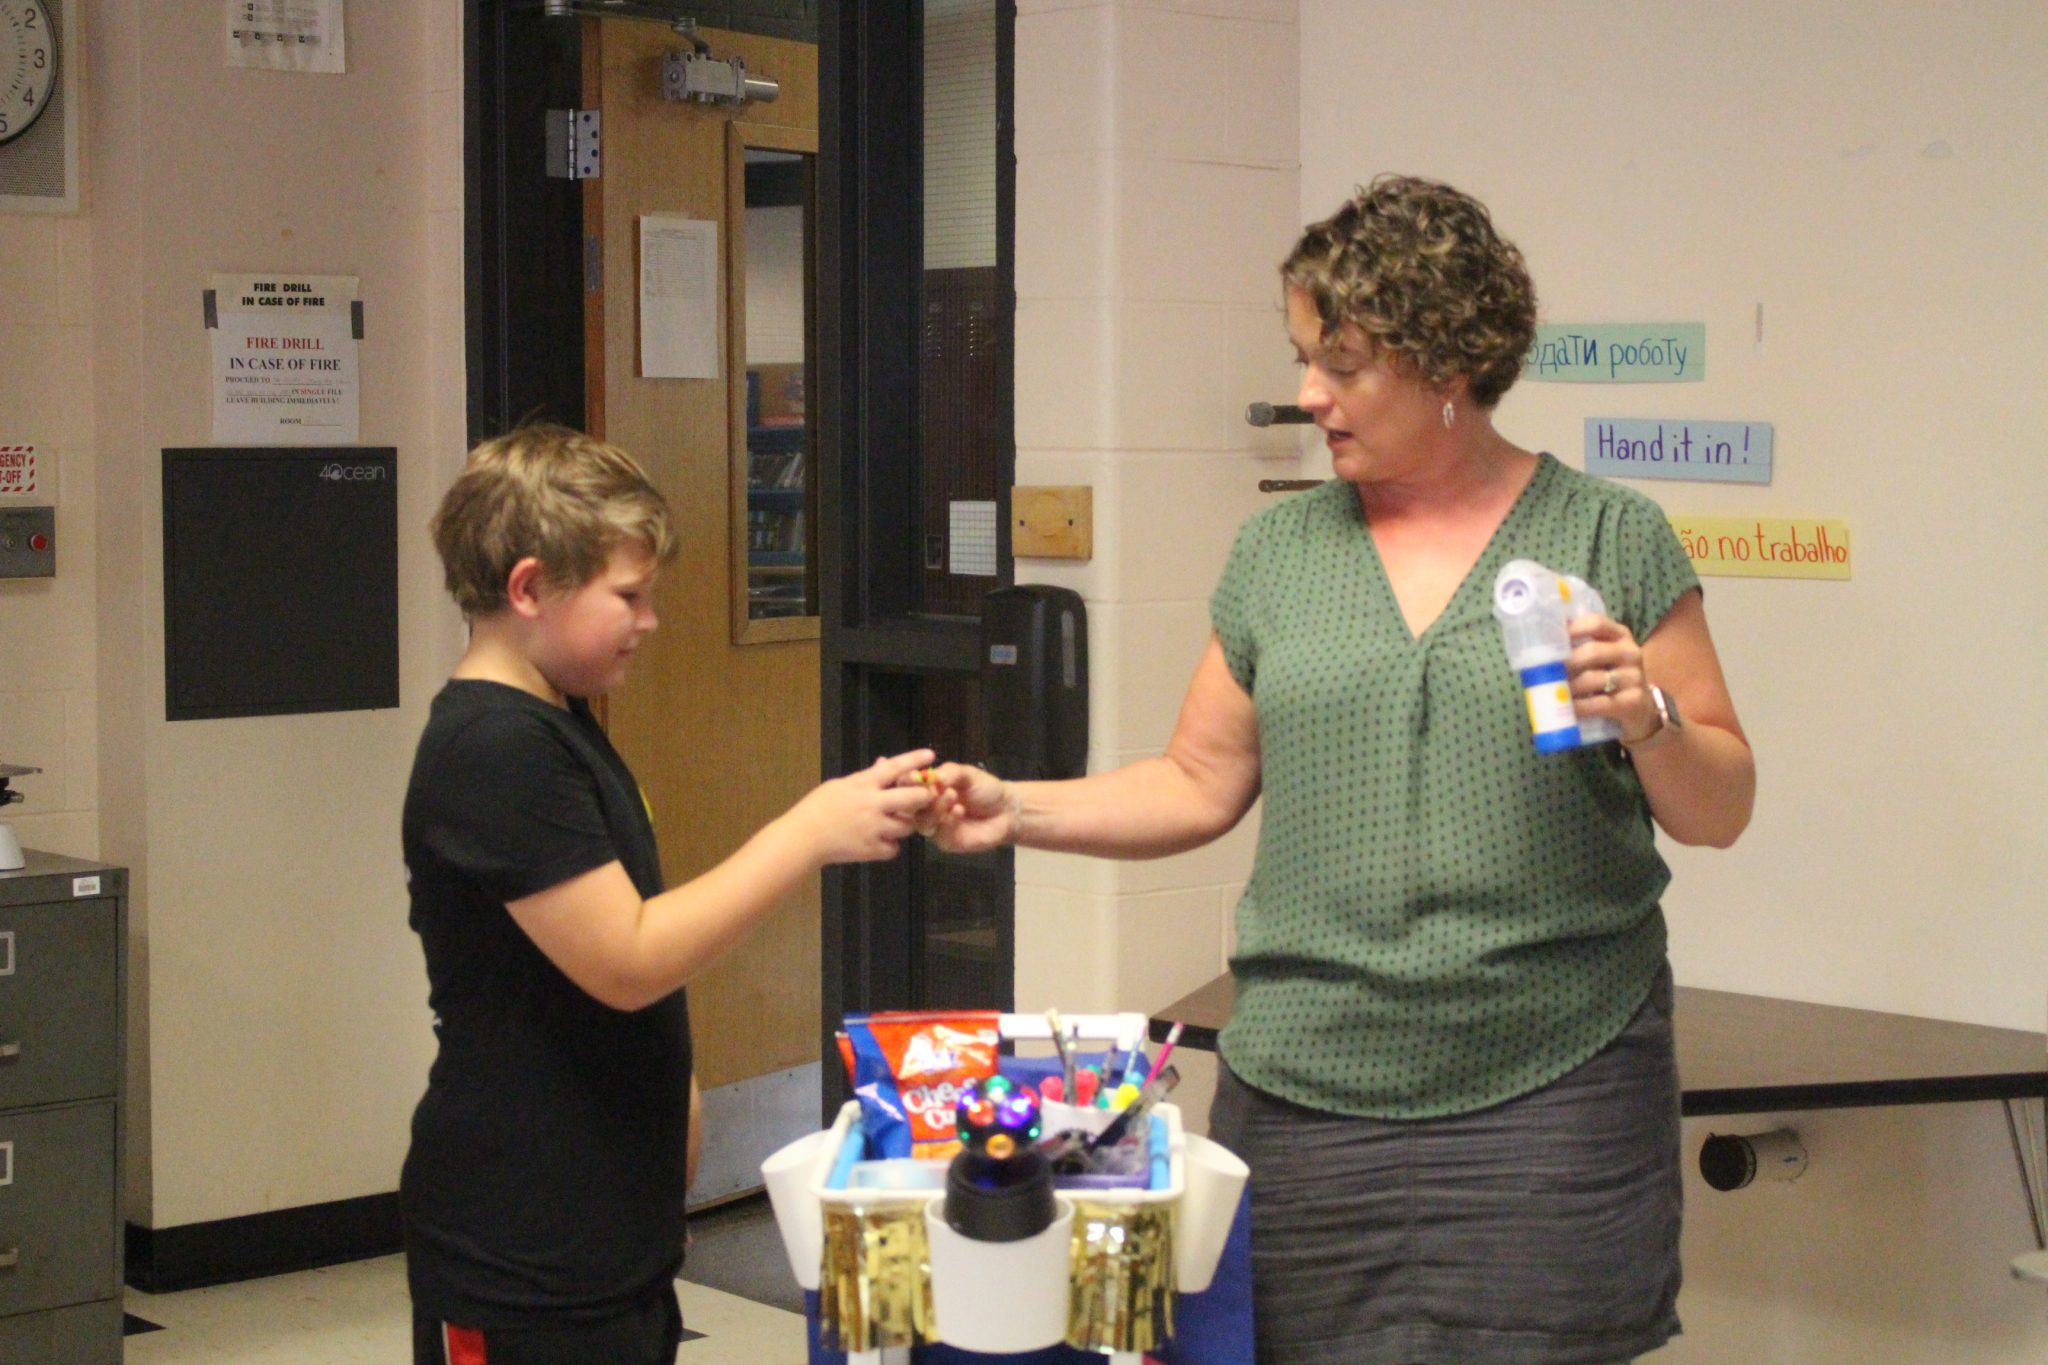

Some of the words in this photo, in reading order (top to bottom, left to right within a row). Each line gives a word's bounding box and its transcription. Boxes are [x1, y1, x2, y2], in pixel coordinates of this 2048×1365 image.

[25, 8, 36, 29] 2
[34, 48, 46, 69] 3
[23, 86, 35, 107] 4
[253, 283, 277, 292] FIRE
[283, 283, 312, 293] DRILL
[242, 297, 255, 306] IN
[258, 297, 283, 306] CASE
[286, 297, 300, 306] OF
[303, 297, 325, 306] FIRE
[246, 336, 279, 350] FIRE
[282, 337, 325, 350] DRILL
[230, 357, 245, 370] IN
[248, 357, 284, 370] CASE
[287, 358, 306, 371] OF
[310, 358, 341, 371] FIRE
[1609, 338, 1687, 379] роботу
[279, 417, 302, 425] ROOM
[1598, 424, 1664, 462] Hand
[1672, 426, 1693, 463] it
[1718, 535, 1750, 561] no
[1754, 522, 1848, 564] trabalho
